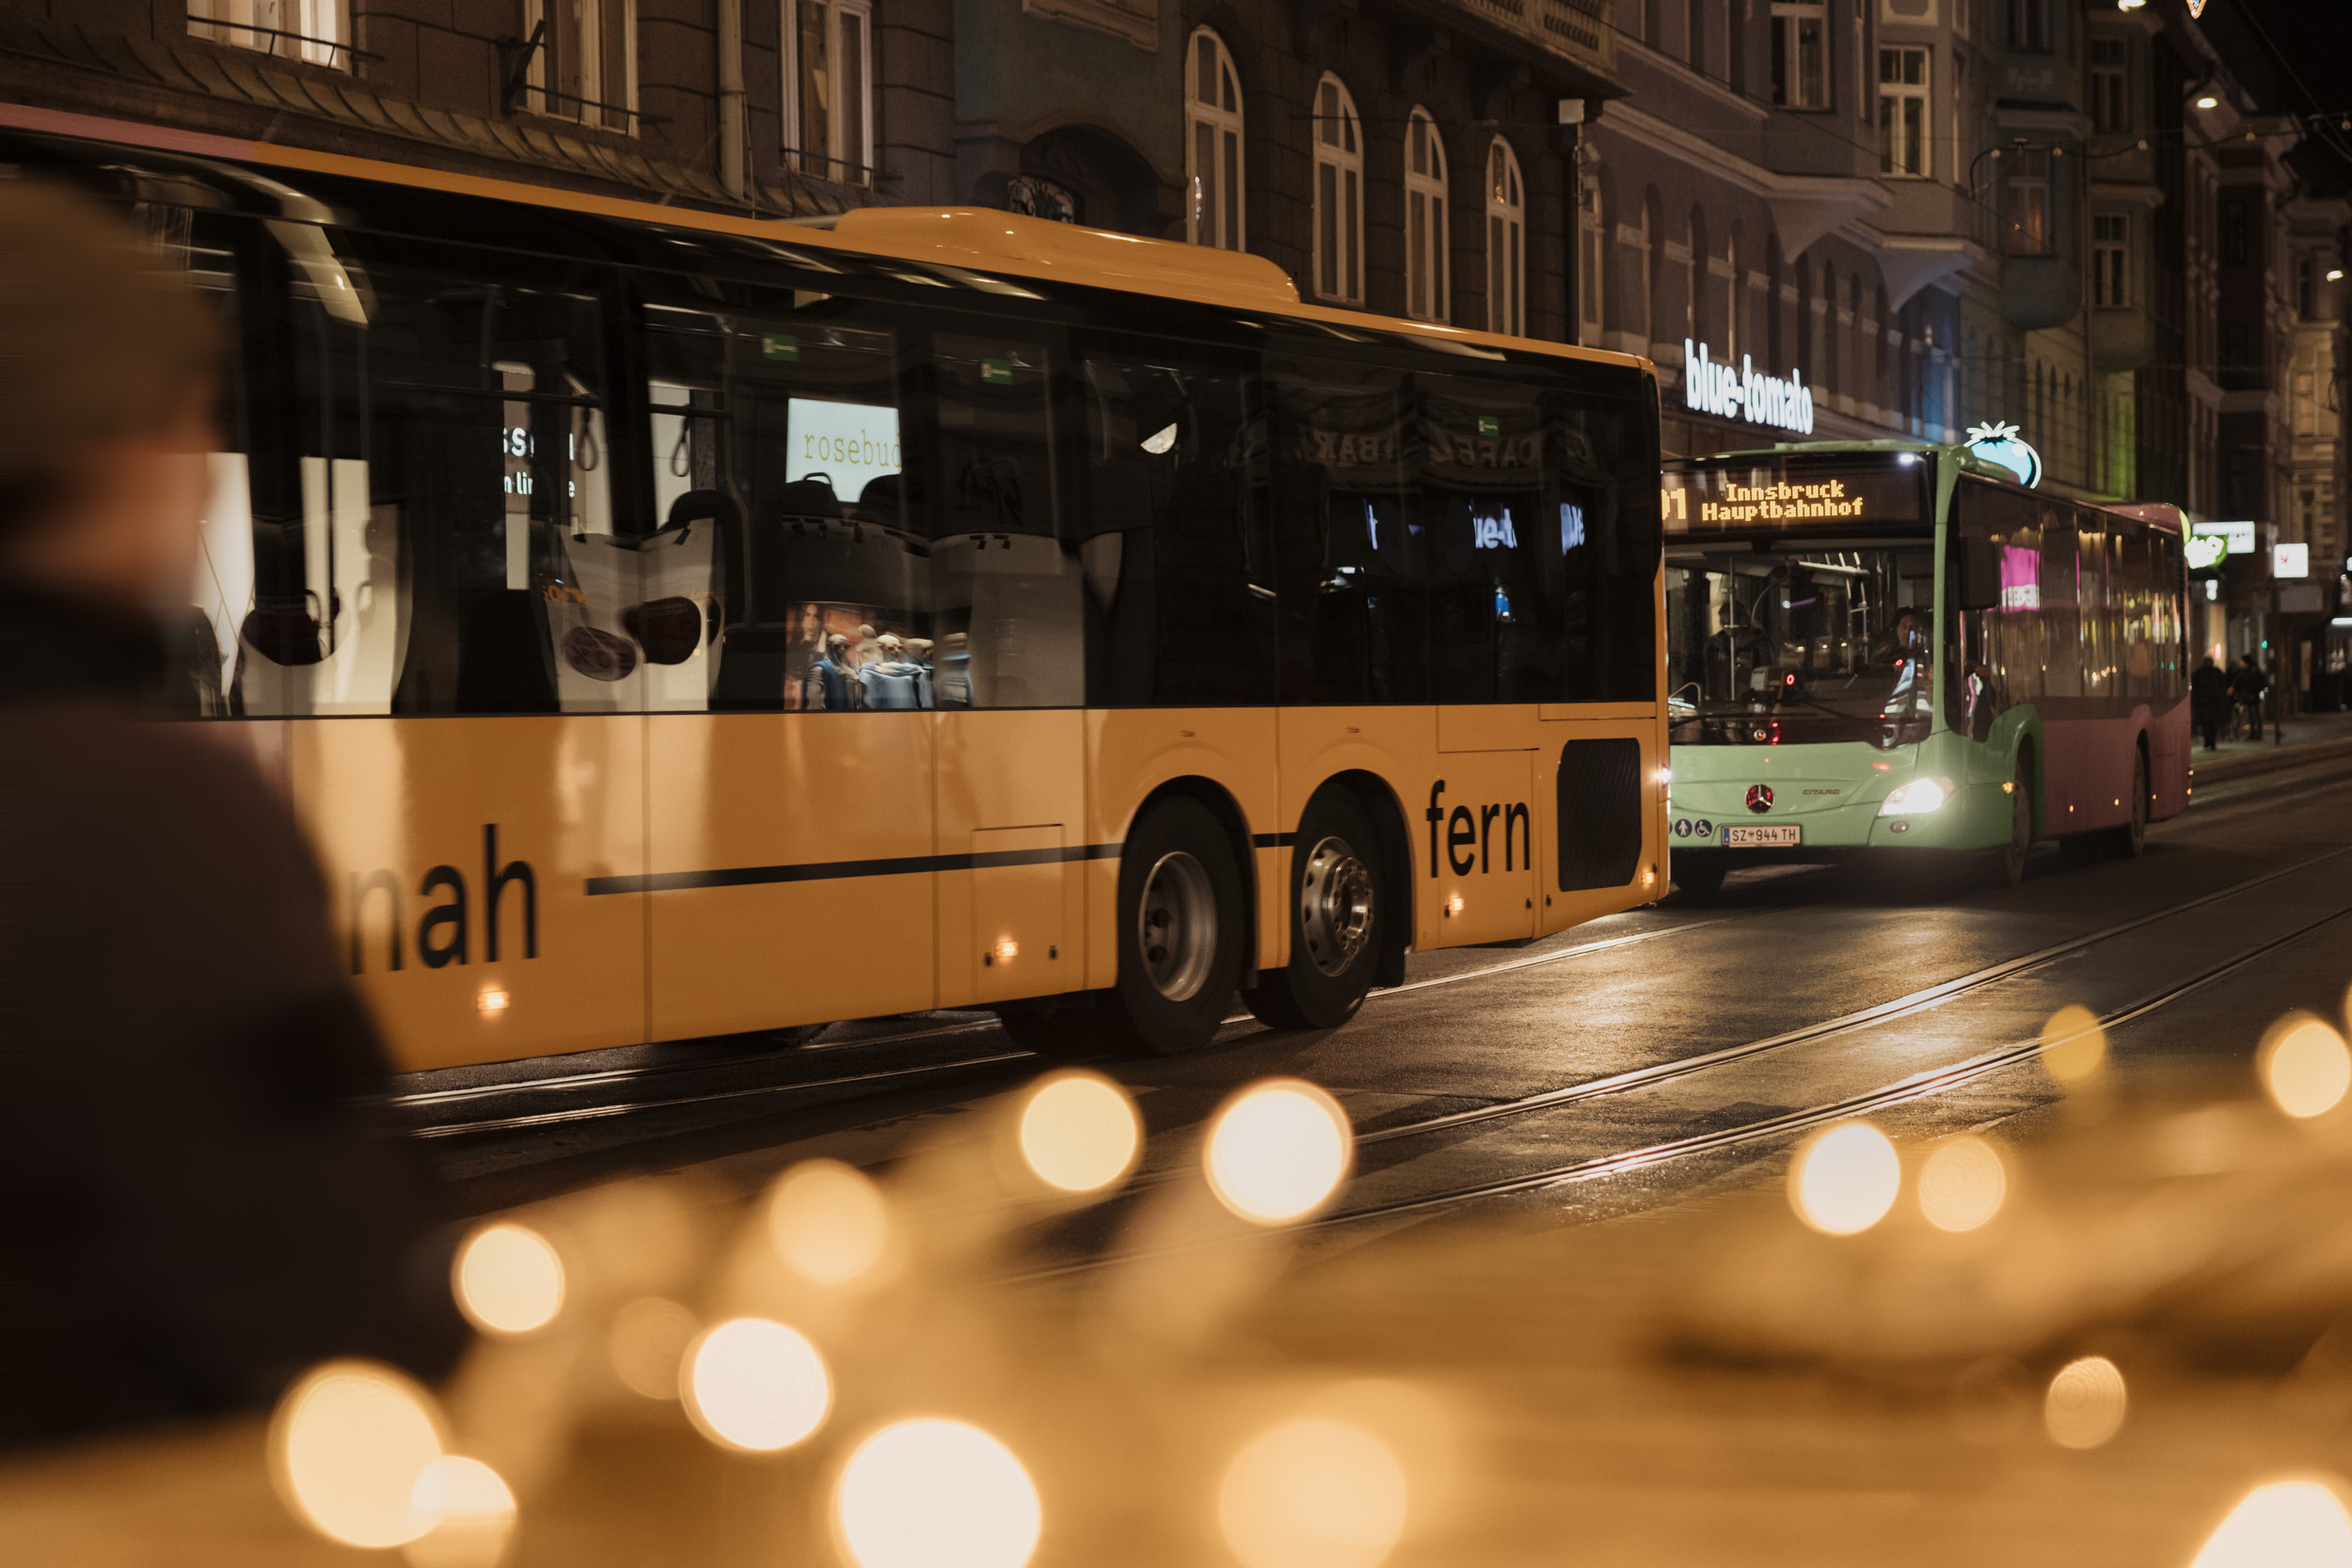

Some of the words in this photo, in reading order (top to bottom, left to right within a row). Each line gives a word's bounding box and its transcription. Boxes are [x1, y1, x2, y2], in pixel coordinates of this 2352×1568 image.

[1685, 338, 1813, 435] blue-tomato
[1726, 479, 1844, 501] Innsbruck
[1702, 497, 1863, 521] Hauptbahnhof
[1426, 779, 1531, 879] fern
[1732, 830, 1747, 842] SZ
[1756, 829, 1778, 841] 944
[1782, 829, 1796, 840] TH
